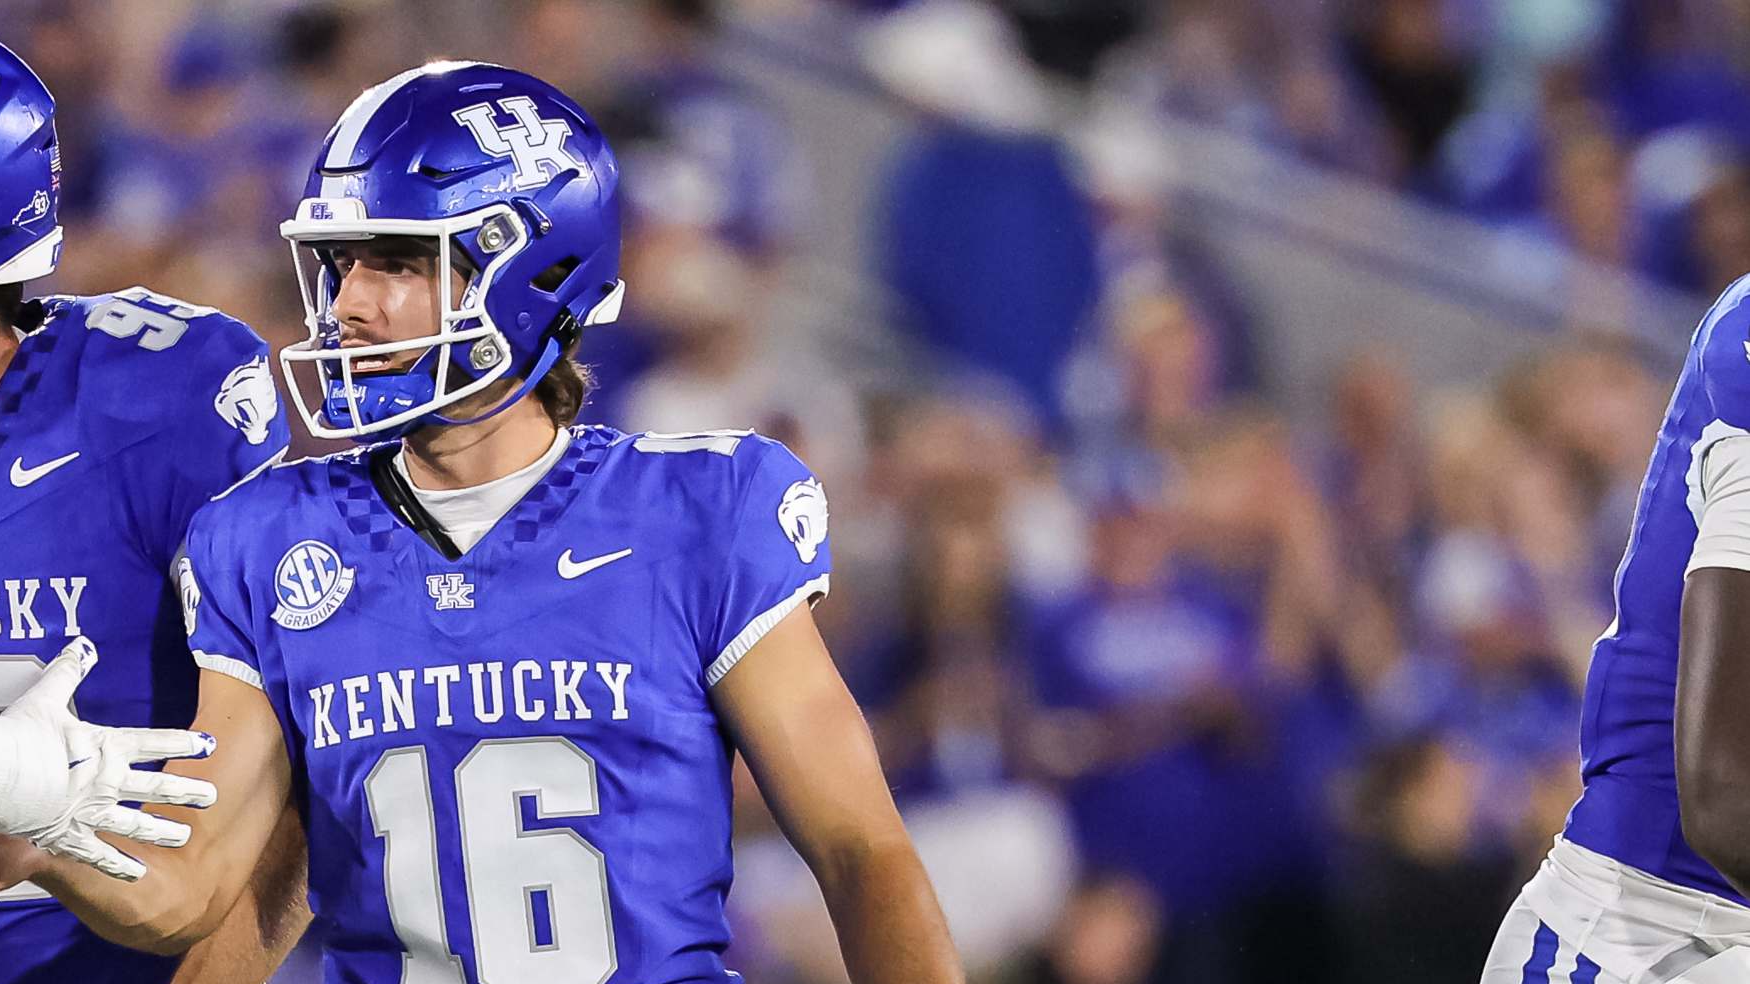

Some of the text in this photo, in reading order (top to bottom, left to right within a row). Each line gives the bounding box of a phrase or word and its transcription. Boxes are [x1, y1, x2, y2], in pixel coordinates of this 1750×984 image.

[451, 95, 591, 192] UK
[34, 198, 47, 215] 93
[277, 543, 339, 609] SEC
[425, 573, 475, 611] UK
[284, 586, 349, 628] GRADUATE
[308, 659, 633, 748] KENTUCKY
